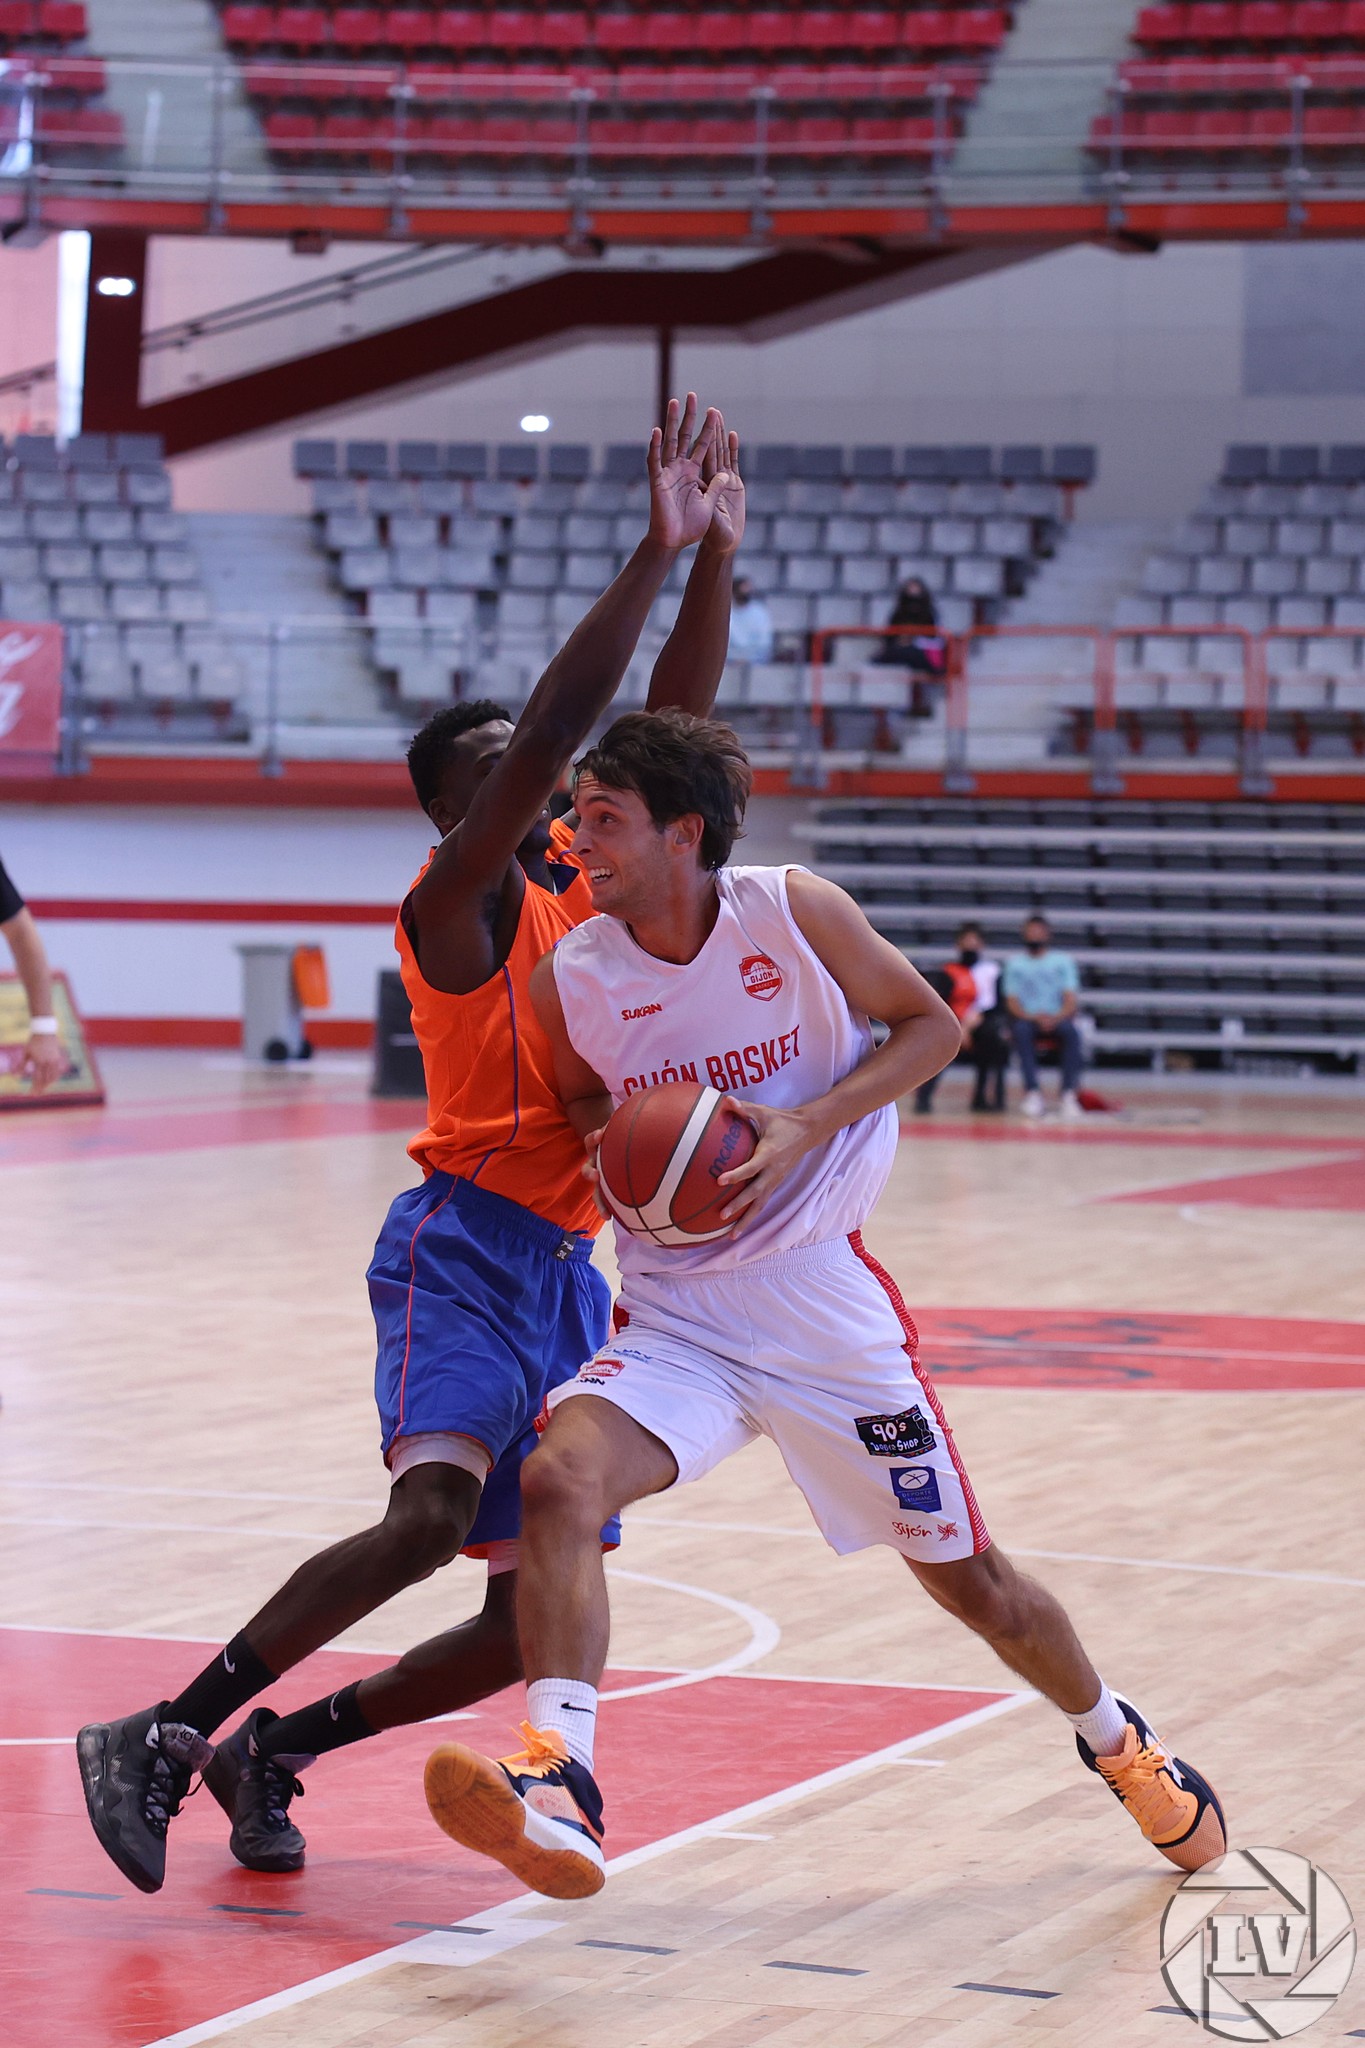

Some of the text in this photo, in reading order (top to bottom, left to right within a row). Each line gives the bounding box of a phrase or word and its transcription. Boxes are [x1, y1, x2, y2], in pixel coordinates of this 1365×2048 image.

[621, 1003, 663, 1021] SUKAN
[705, 1024, 800, 1093] BASKET
[896, 1438, 919, 1452] SHOP
